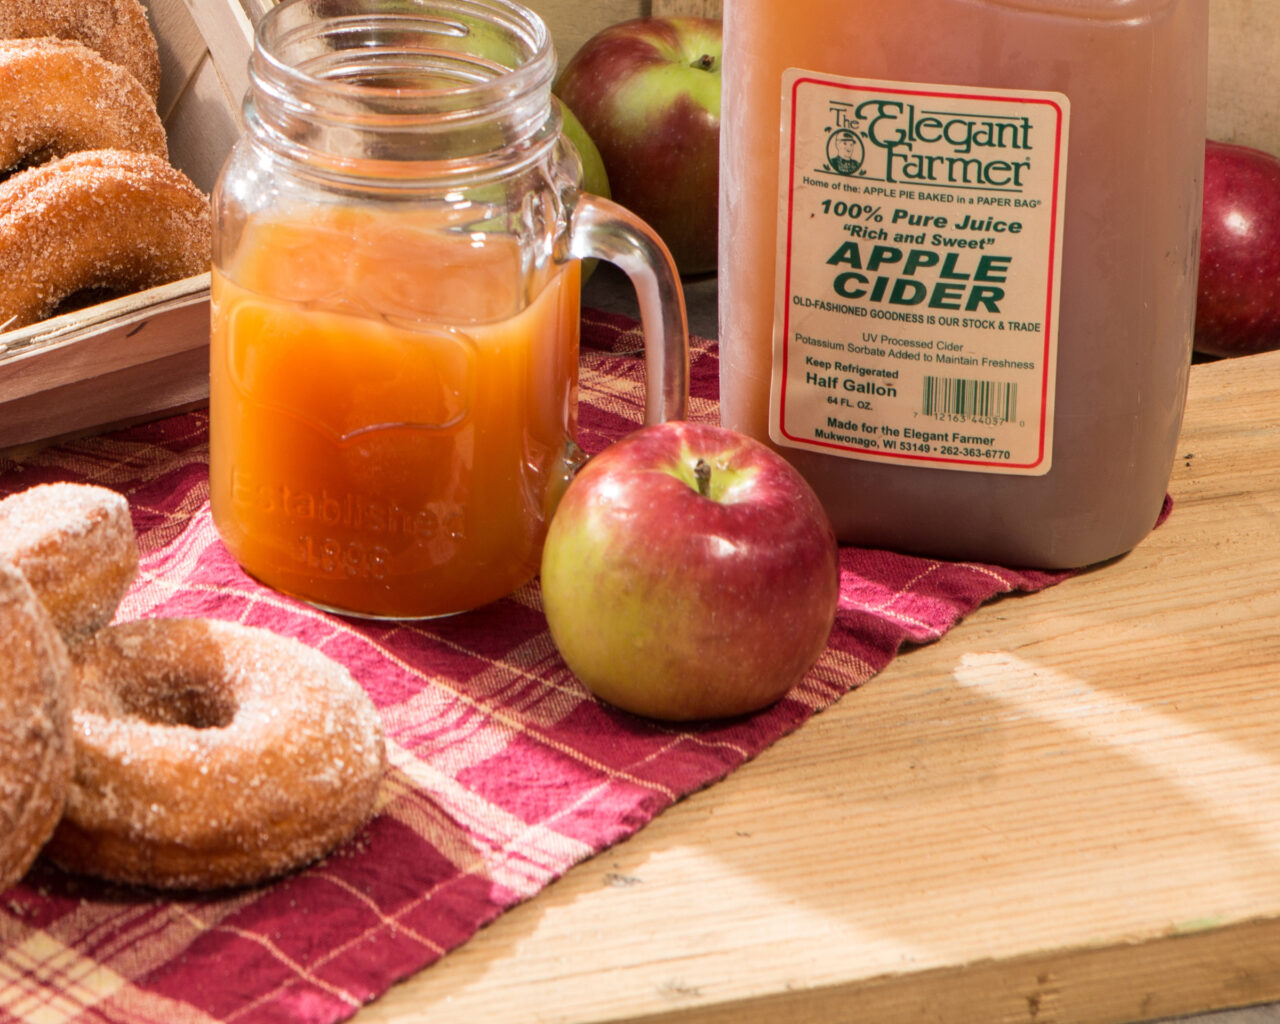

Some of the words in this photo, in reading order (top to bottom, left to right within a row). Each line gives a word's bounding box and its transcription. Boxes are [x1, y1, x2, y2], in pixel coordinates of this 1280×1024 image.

[829, 107, 860, 129] The
[855, 99, 1033, 153] Elegant
[883, 140, 1030, 186] Farmer
[802, 176, 829, 188] Home
[831, 182, 841, 190] of
[843, 184, 861, 193] the:
[863, 186, 896, 198] APPLE
[899, 190, 915, 199] PIE
[918, 192, 954, 203] BAKED
[956, 194, 965, 204] in
[977, 196, 1011, 207] PAPER
[821, 199, 883, 223] 100%
[891, 208, 948, 228] Pure
[954, 214, 1023, 233] Juice
[893, 232, 926, 244] and
[825, 241, 1012, 283] APPLE
[833, 271, 1005, 313] CIDER
[792, 295, 868, 317] OLD-FASHIONED
[869, 308, 924, 324] GOODNESS
[926, 315, 936, 325] IS
[938, 316, 959, 327] OUR
[962, 318, 996, 329] STOCK
[998, 321, 1005, 330] &
[1008, 321, 1041, 332] TRADE
[795, 332, 844, 351] Potassium
[847, 343, 886, 357] Sorbate
[888, 349, 920, 361] Added
[923, 352, 933, 362] to
[936, 353, 978, 366] Maintain
[981, 357, 1035, 370] Freshness
[862, 332, 878, 343] UV
[880, 334, 933, 349] Processed
[936, 340, 964, 352] Cider
[806, 356, 831, 370] Keep
[834, 361, 899, 379] Refrigerated
[806, 371, 838, 389] Half
[843, 379, 897, 397] Gallon
[827, 396, 838, 405] 64
[840, 397, 854, 408] FL.
[857, 400, 873, 411] OZ.
[814, 428, 880, 449] Mukwonago,
[883, 439, 896, 449] WI
[899, 441, 930, 453] 53149
[941, 445, 1010, 459] 262-363-6770
[827, 416, 858, 432] Made
[861, 422, 878, 434] for
[881, 425, 900, 437] the
[904, 427, 949, 443] Elegant
[952, 432, 996, 446] Farmer
